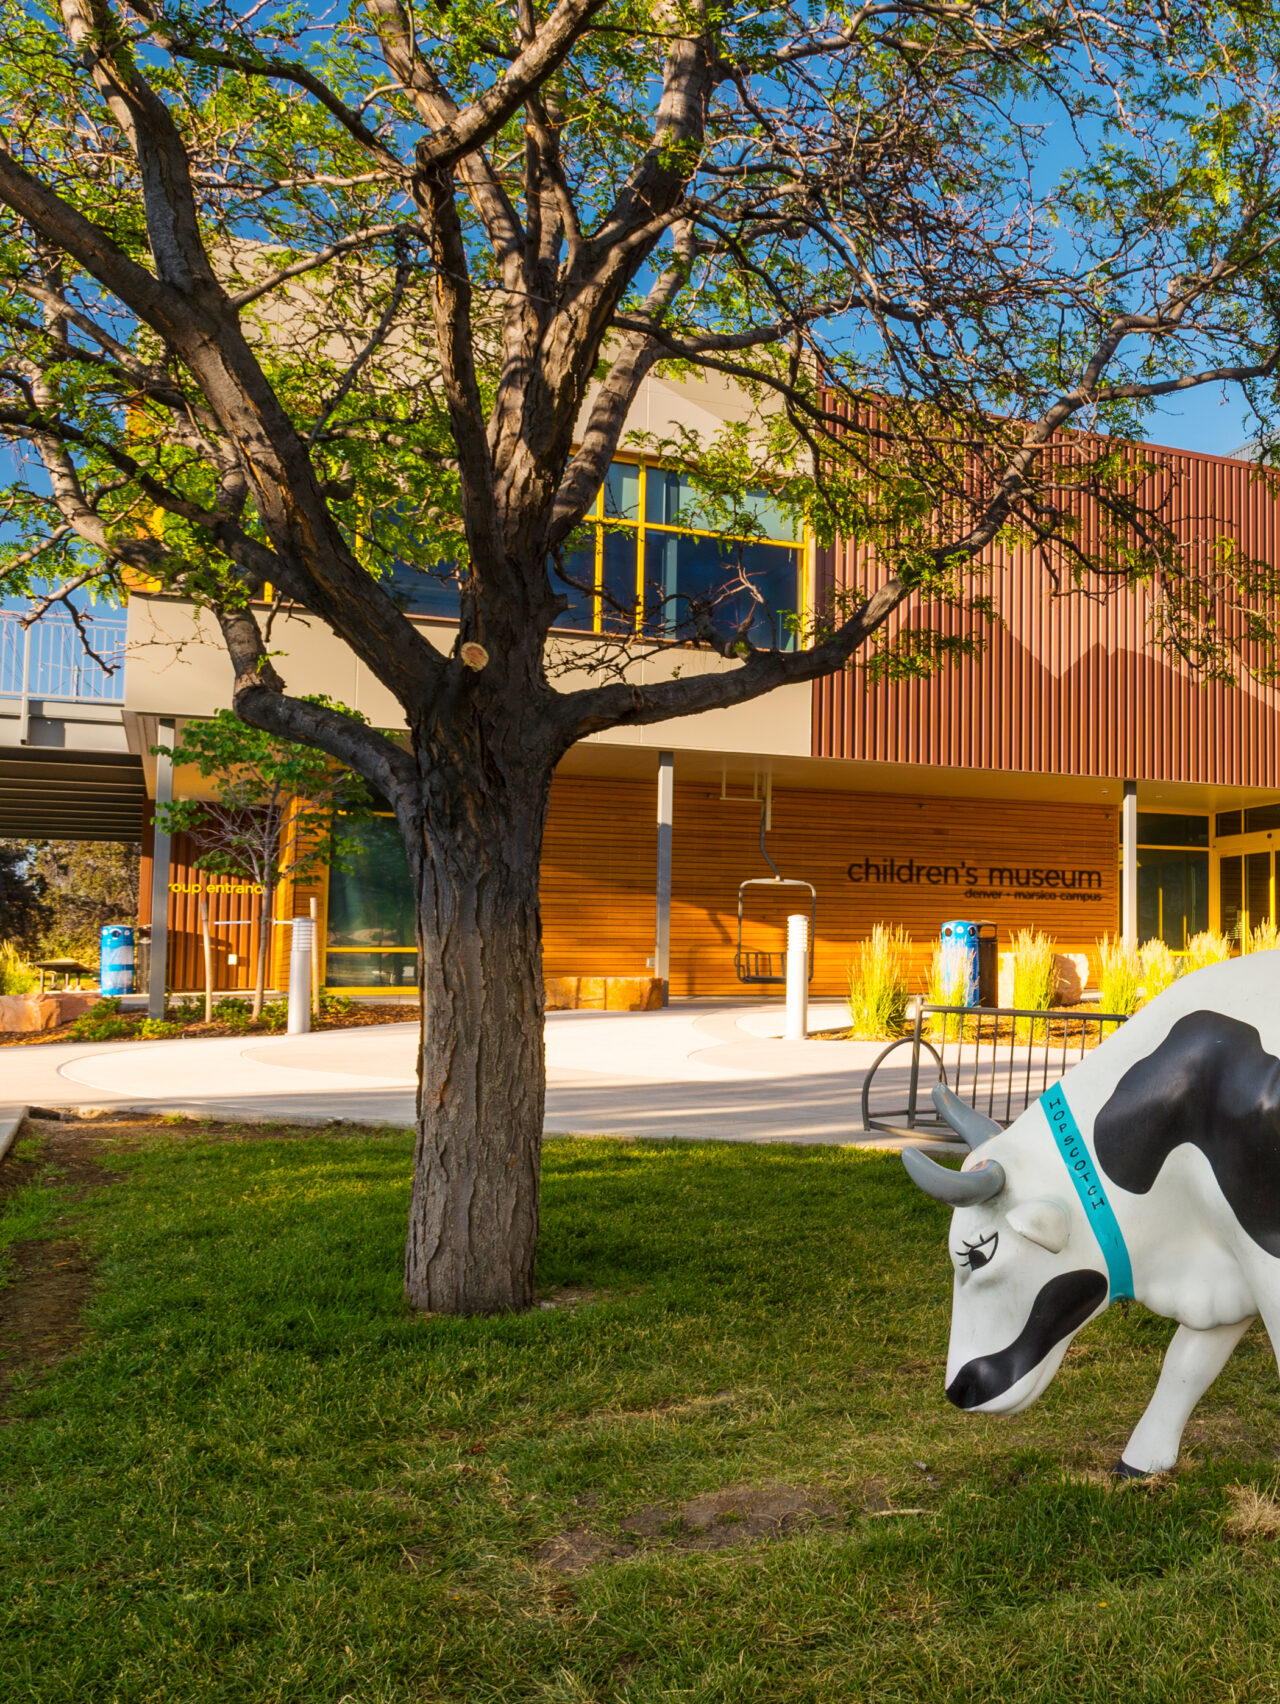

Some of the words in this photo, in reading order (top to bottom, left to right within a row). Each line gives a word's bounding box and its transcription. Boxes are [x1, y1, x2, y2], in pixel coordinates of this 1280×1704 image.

[847, 857, 979, 885] children's
[988, 867, 1102, 888] museum
[206, 882, 266, 895] entranc
[964, 888, 1003, 899] denver
[1059, 893, 1102, 903] campus
[1048, 1097, 1105, 1210] HOPSCOTCH
